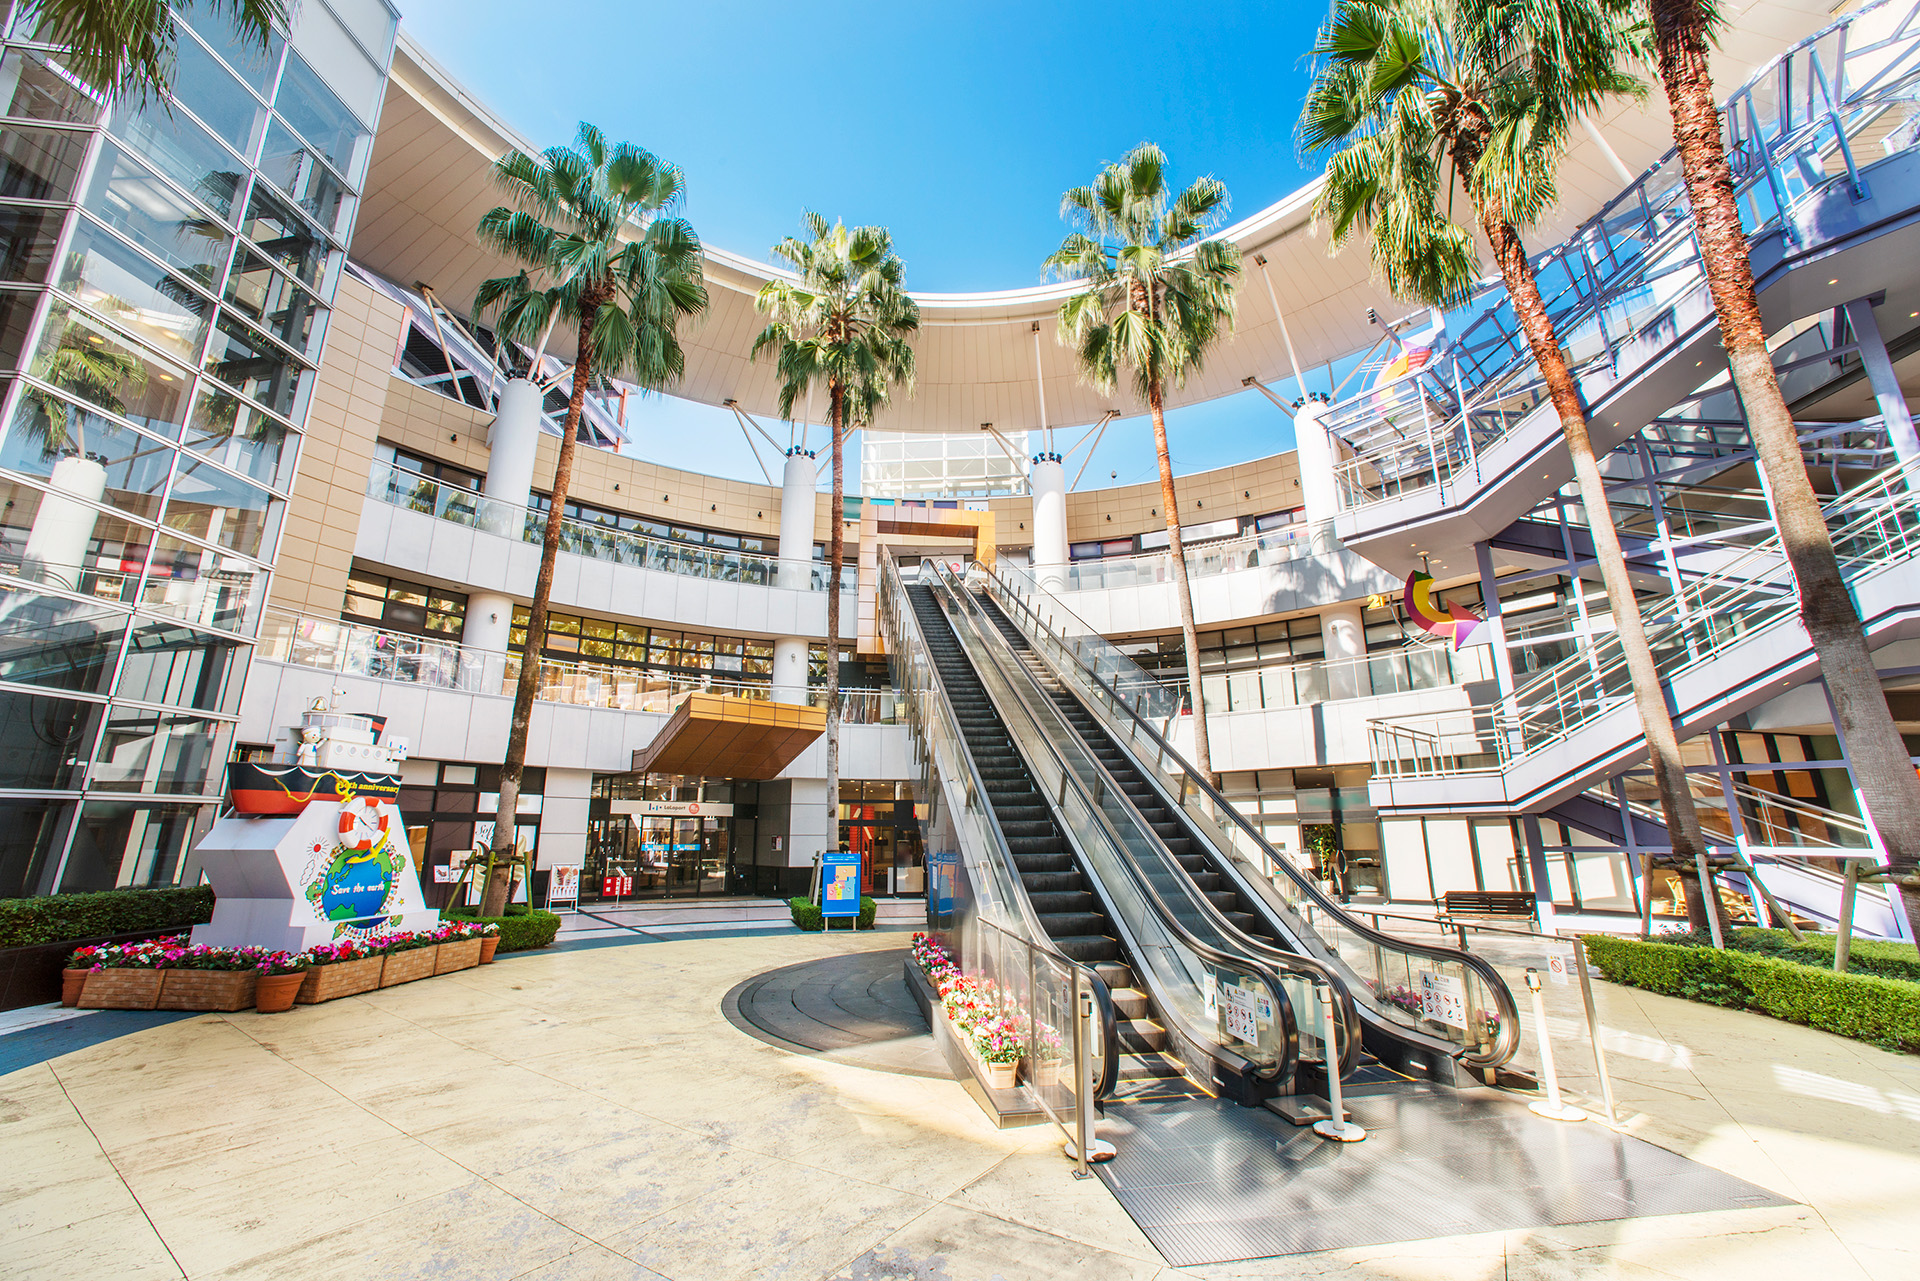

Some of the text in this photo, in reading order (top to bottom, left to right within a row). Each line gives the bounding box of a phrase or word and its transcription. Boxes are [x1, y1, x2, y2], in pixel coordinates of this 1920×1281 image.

[358, 783, 399, 794] anniversary
[331, 881, 385, 895] Save the earth
